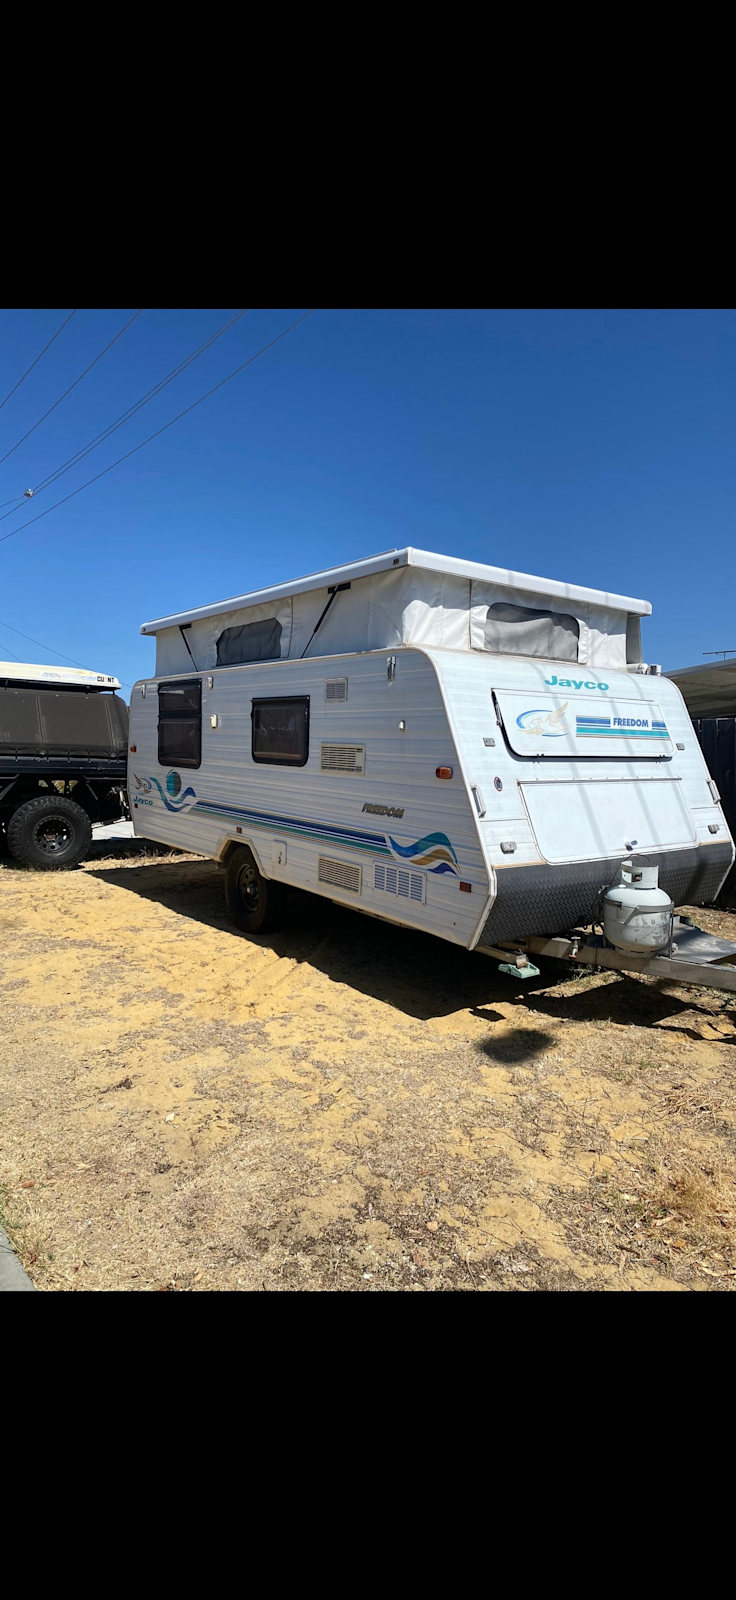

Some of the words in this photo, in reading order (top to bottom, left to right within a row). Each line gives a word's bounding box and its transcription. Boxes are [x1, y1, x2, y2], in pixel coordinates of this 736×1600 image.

[544, 675, 609, 690] Jayco
[613, 717, 649, 728] FREEDOM
[133, 795, 153, 806] Jayco
[361, 802, 405, 819] FREEDOM
